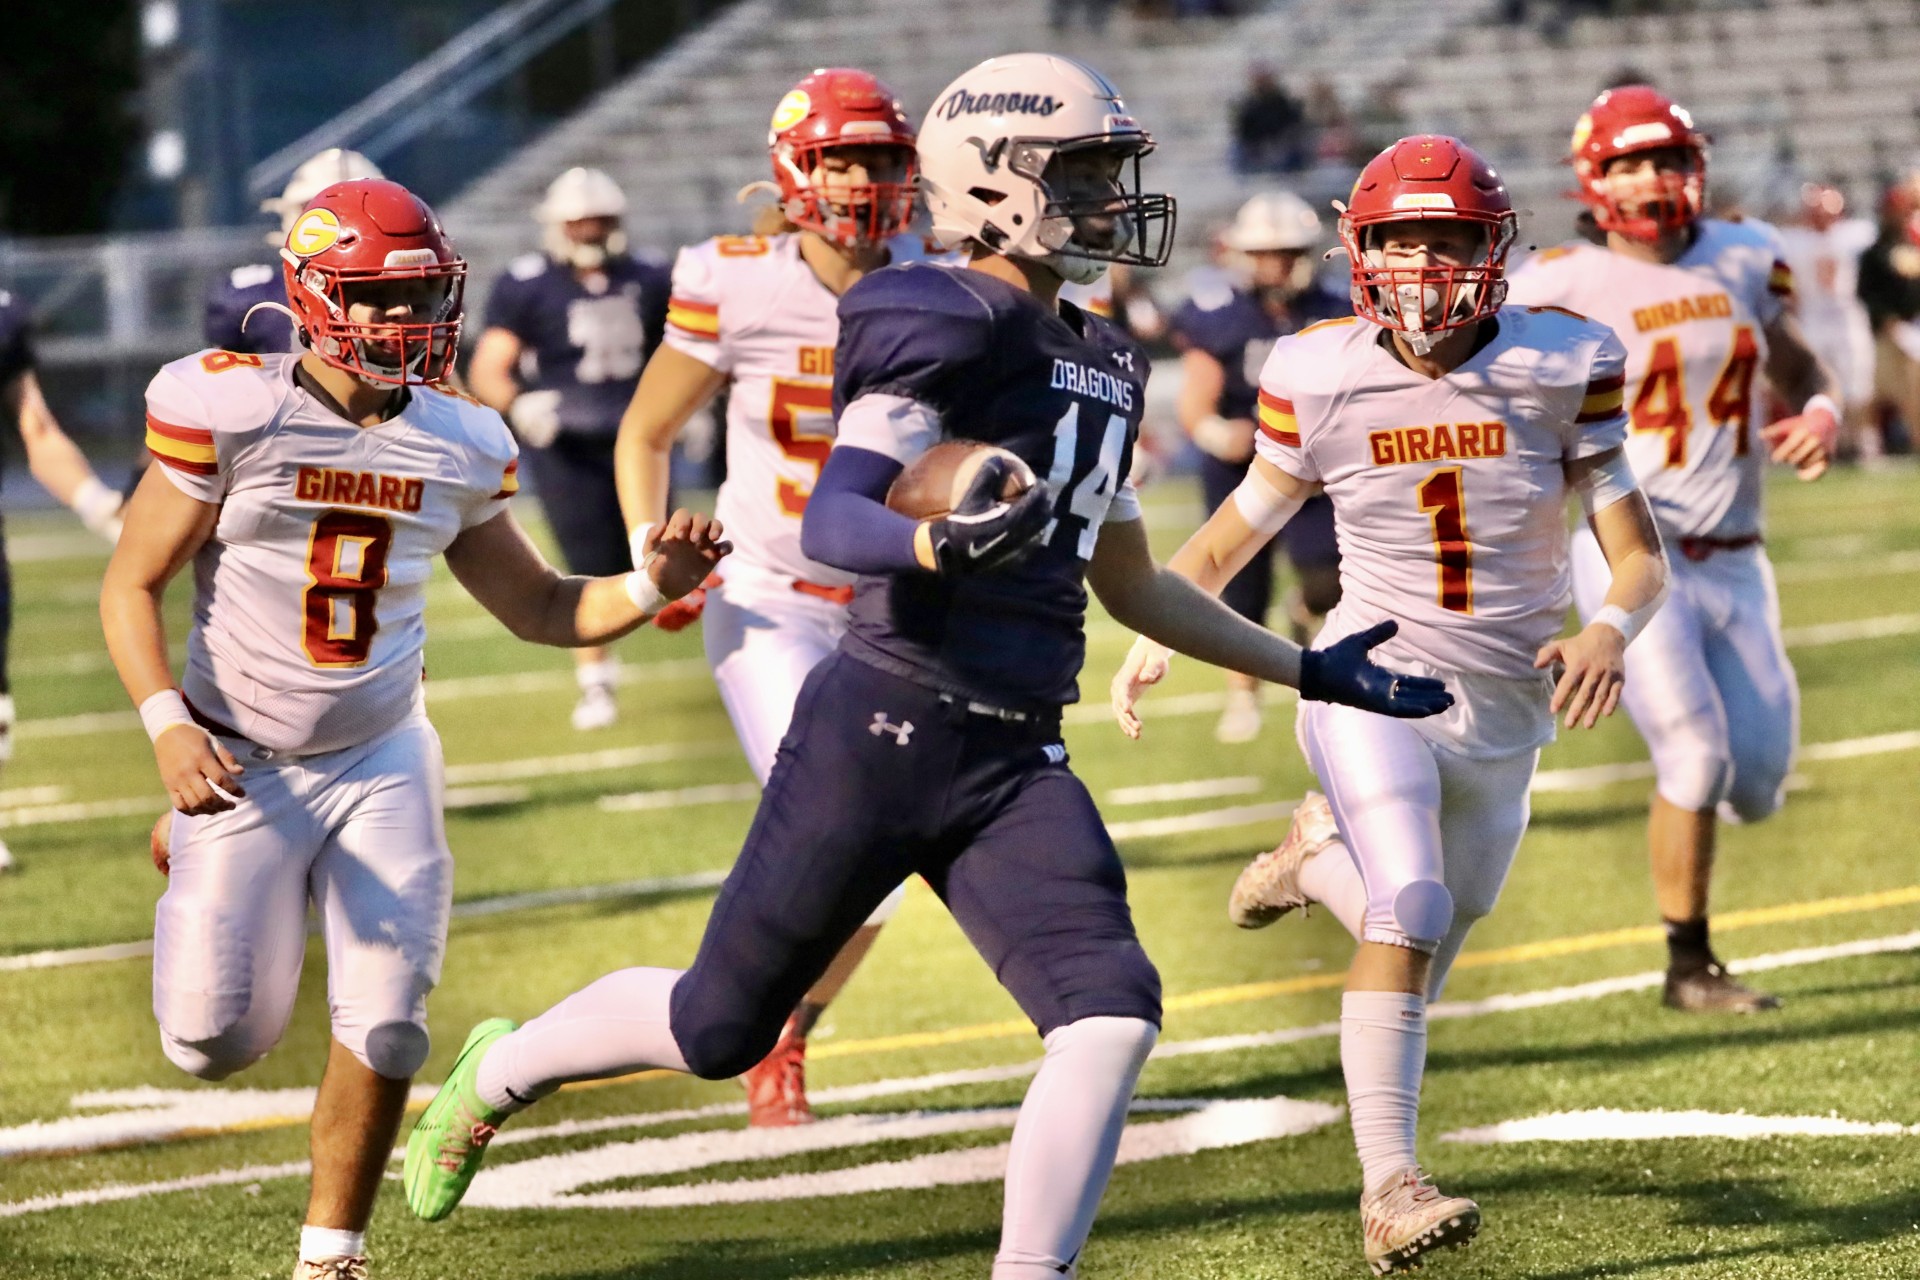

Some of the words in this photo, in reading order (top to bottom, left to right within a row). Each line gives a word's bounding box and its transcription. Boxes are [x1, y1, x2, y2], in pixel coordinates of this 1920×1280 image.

[936, 88, 1064, 121] Dragons
[289, 207, 341, 257] G
[1632, 292, 1732, 333] GIRARD
[1050, 358, 1133, 412] DRAGONS
[1631, 325, 1760, 468] 44
[1369, 420, 1506, 466] GIRARD
[294, 465, 424, 513] GIRARD
[1041, 401, 1127, 561] 14
[1416, 465, 1474, 614] 1
[301, 508, 393, 668] 8
